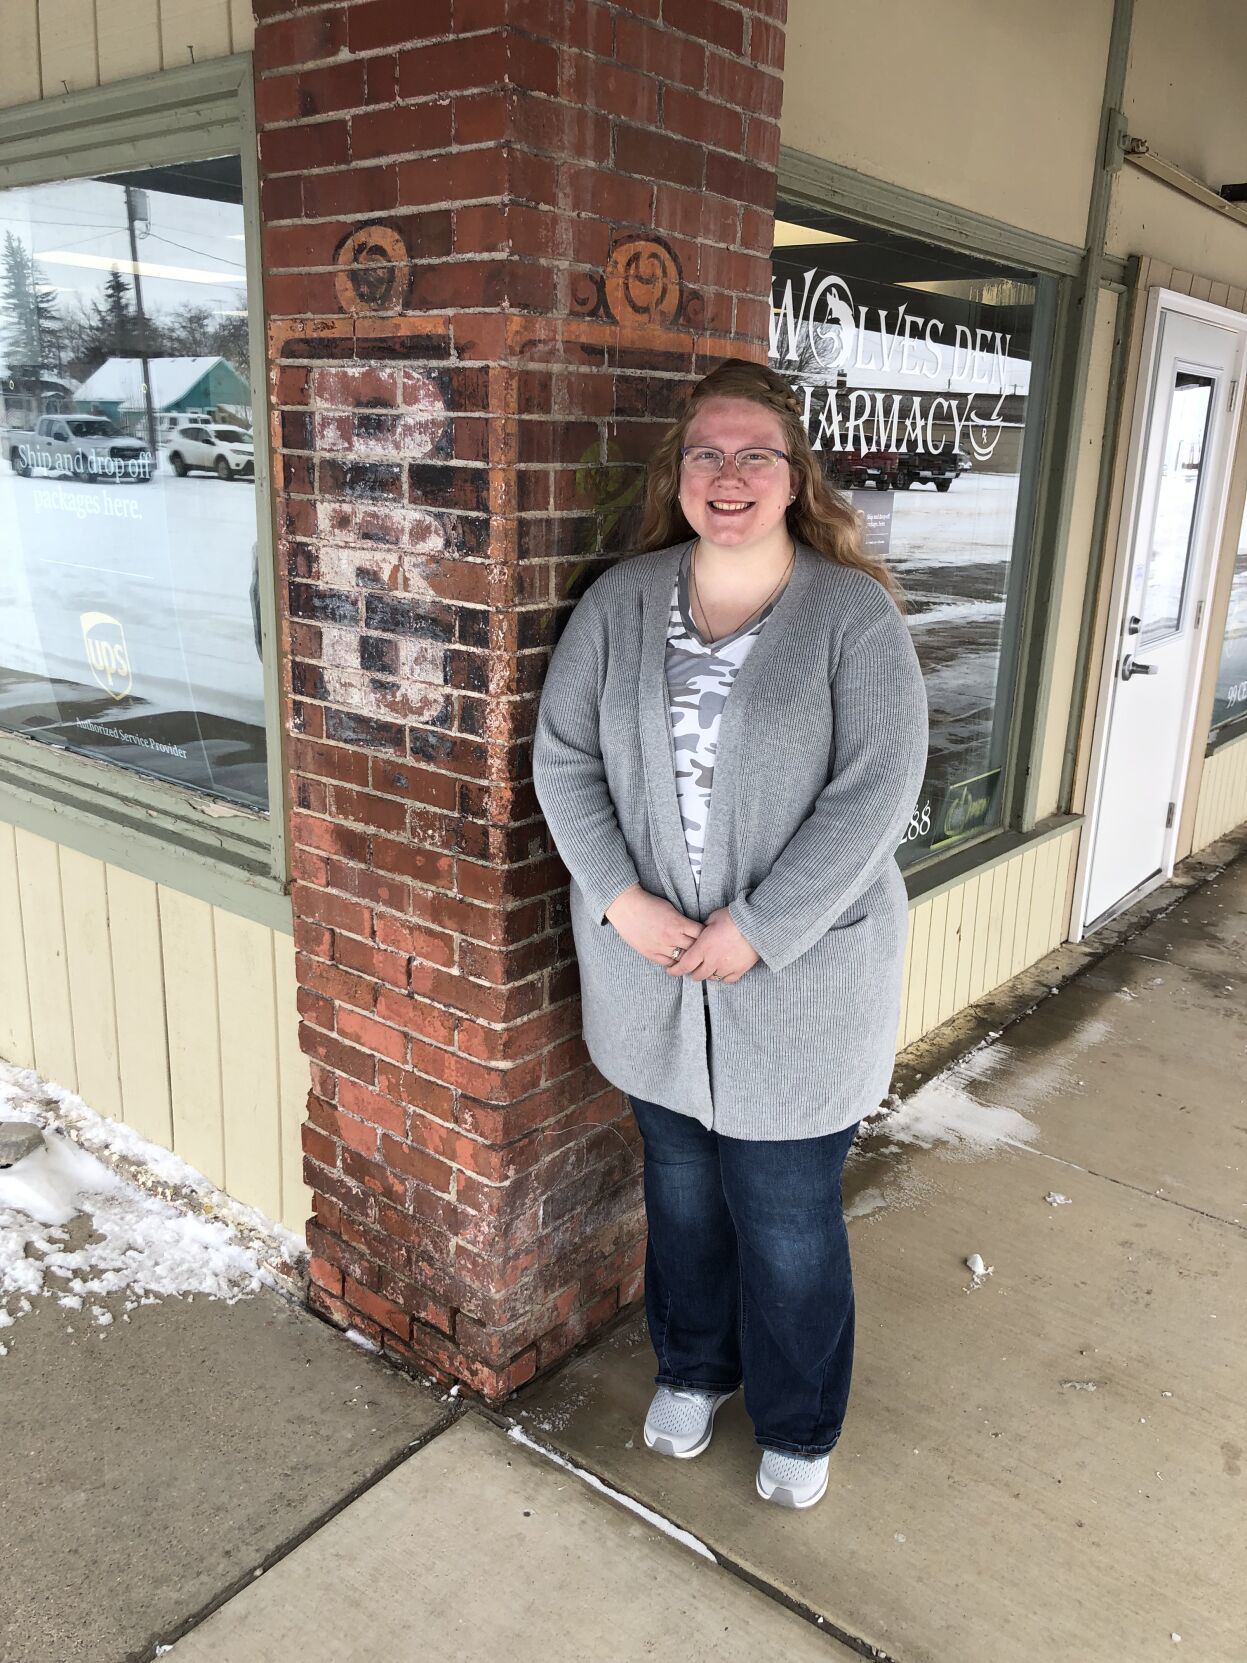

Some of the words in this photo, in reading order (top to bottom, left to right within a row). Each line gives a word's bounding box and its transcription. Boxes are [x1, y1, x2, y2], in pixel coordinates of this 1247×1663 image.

[768, 266, 945, 379] WOLVES
[951, 324, 1012, 388] DEN
[790, 385, 975, 459] HARMACY
[18, 445, 52, 477] Ship
[55, 447, 85, 474] and
[87, 448, 125, 484] drop
[128, 450, 152, 479] off
[32, 485, 101, 519] packages
[102, 489, 143, 519] here.
[76, 716, 120, 740] Authorized
[119, 729, 150, 748] Service
[148, 738, 188, 760] Provider
[899, 800, 931, 845] 88
